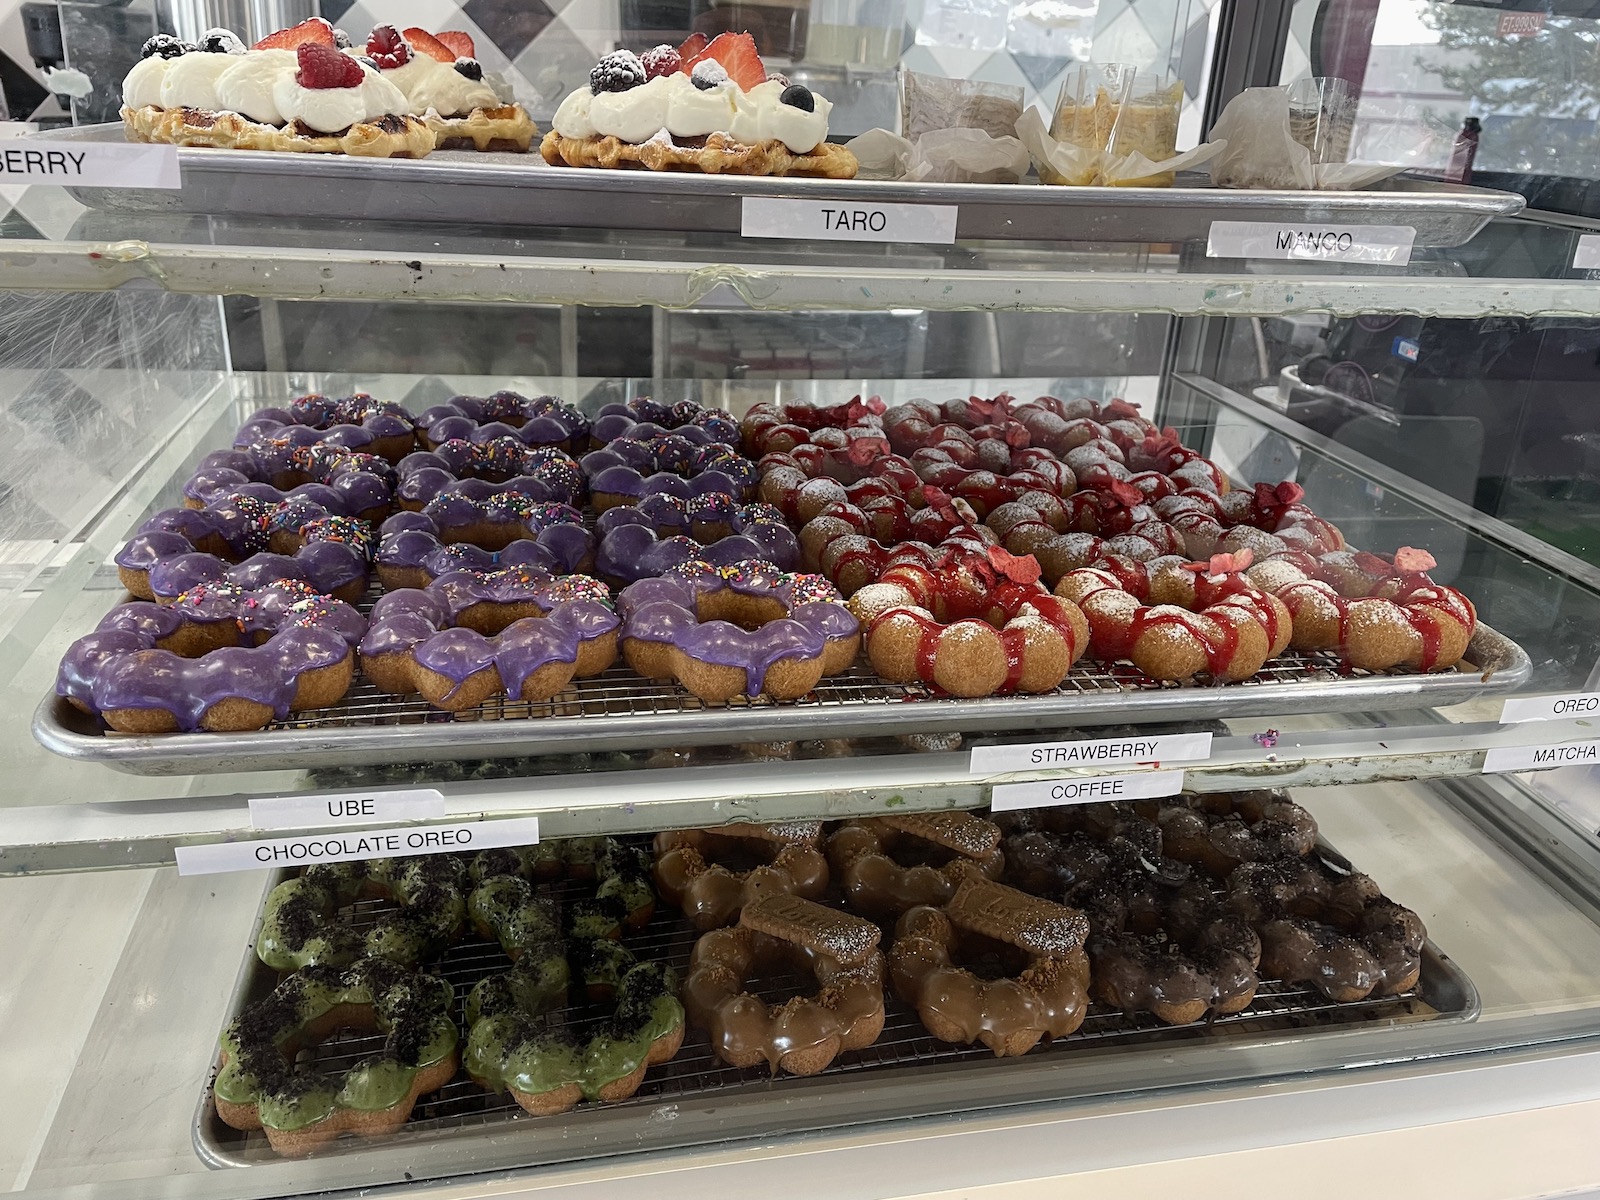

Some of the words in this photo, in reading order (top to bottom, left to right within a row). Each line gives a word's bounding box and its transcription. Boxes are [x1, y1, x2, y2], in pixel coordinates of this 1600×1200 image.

[0, 150, 86, 175] ERRY
[821, 209, 887, 232] TARO
[1276, 231, 1353, 251] MANGO
[1553, 697, 1599, 714] OREO
[1031, 742, 1159, 763] STRAWBERRY
[1533, 745, 1597, 763] MATCHA
[1051, 780, 1124, 799] COFFEE
[328, 799, 375, 817] UBE
[255, 835, 400, 862] CHOCOLATE
[407, 829, 473, 848] OREO
